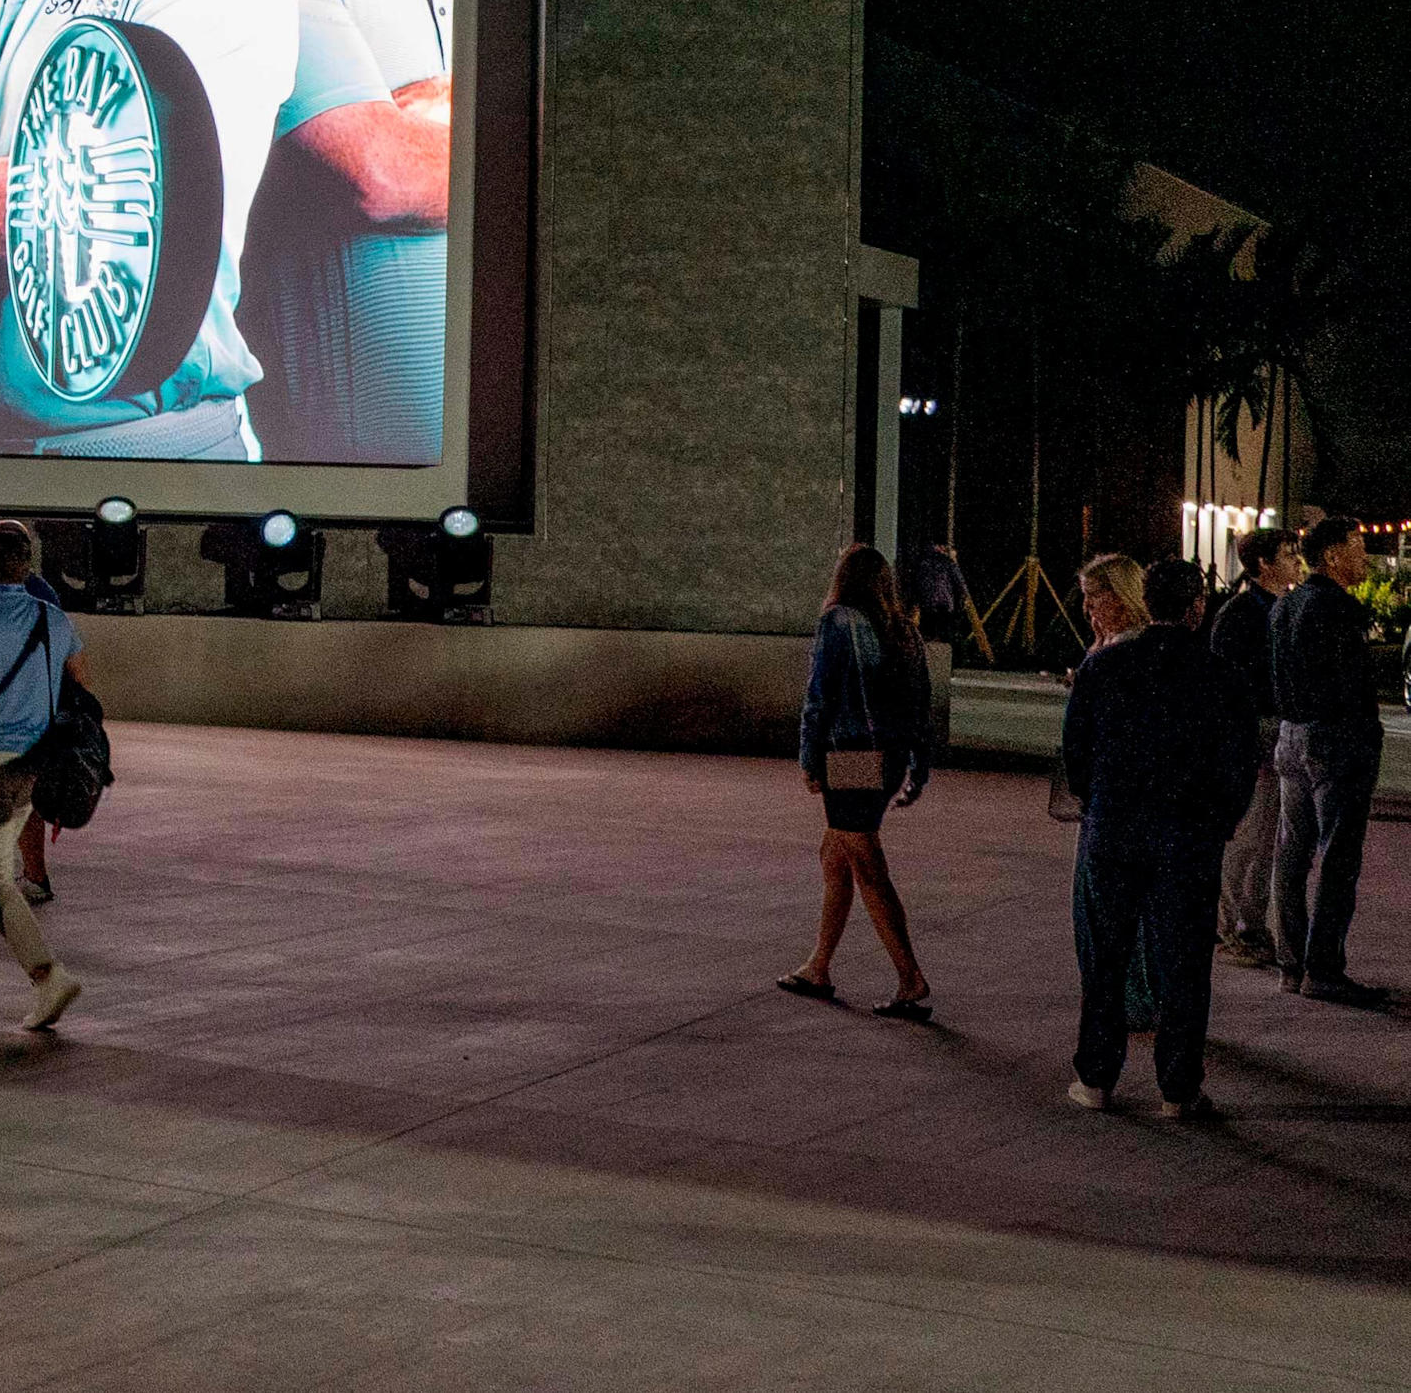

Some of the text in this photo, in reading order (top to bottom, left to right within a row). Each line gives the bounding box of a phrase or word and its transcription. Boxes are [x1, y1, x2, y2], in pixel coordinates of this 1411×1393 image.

[21, 45, 128, 150] THE BAY
[13, 241, 134, 375] GOLF CLUB
